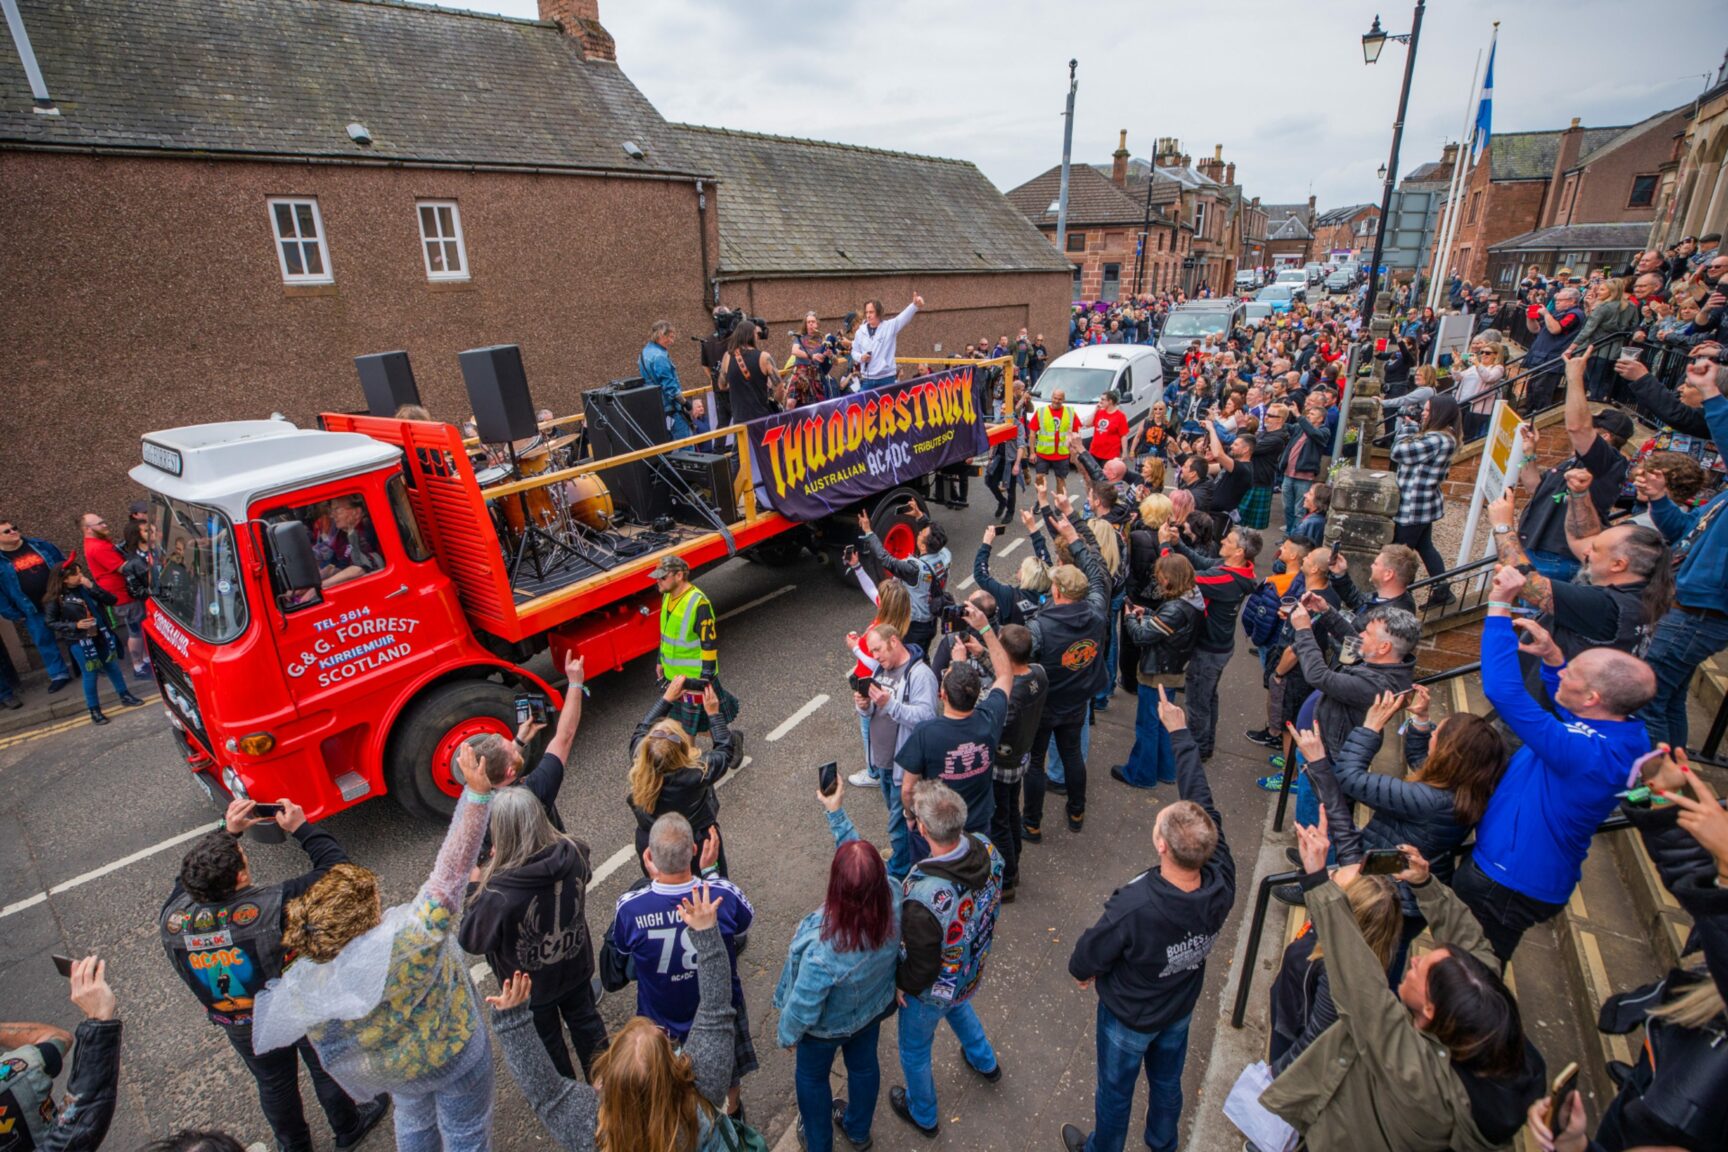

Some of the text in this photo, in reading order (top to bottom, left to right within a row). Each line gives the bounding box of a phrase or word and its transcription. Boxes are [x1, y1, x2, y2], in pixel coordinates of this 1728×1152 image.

[761, 369, 976, 498] THUNDERSTRUCK
[804, 462, 866, 495] AUSTRALIAN
[913, 435, 941, 454] TRIBUTE
[313, 605, 371, 632] TEL. 3814
[336, 618, 419, 643] FORREST
[318, 633, 397, 671] KIRRIEMUIR
[318, 642, 412, 688] SCOTLAND
[635, 912, 664, 928] HIGH
